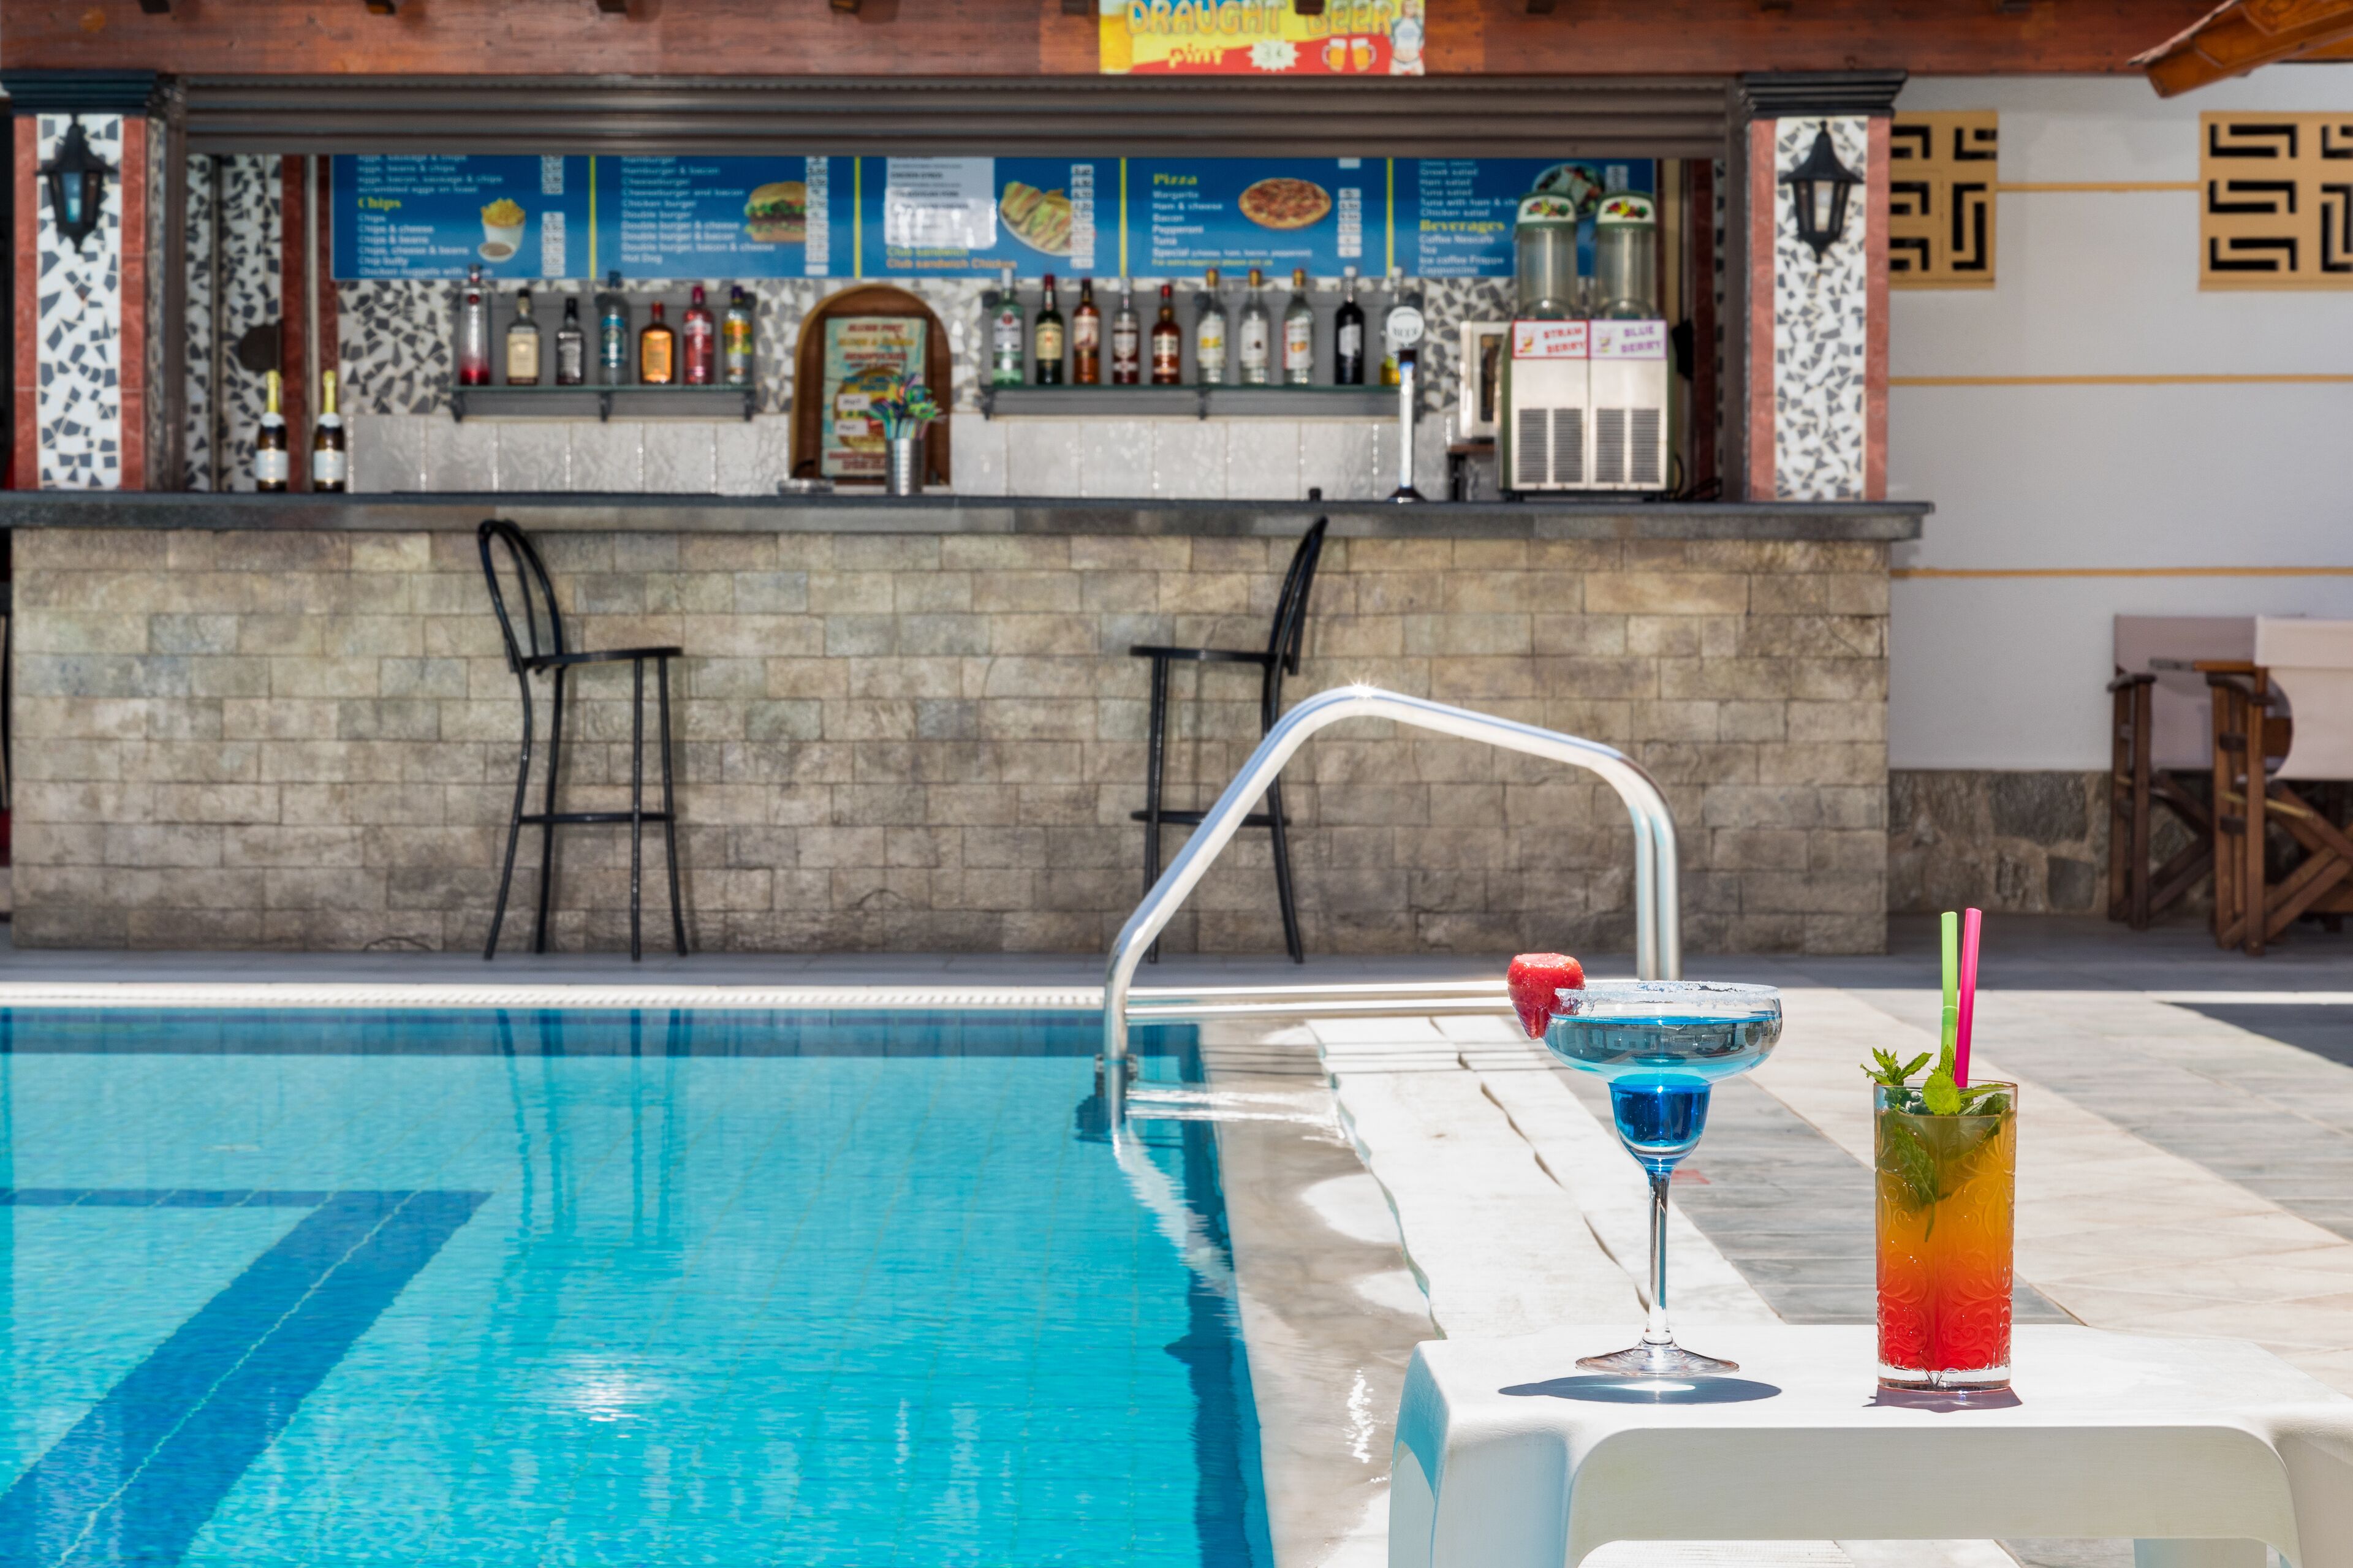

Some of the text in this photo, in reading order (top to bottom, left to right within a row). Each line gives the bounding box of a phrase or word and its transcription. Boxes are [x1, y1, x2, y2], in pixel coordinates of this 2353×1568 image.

[1126, 0, 1393, 36] DRAUGHT BEER
[1169, 42, 1224, 68] pint
[622, 167, 675, 176] Hamburger
[622, 176, 690, 187] Cheeseburger
[1153, 173, 1197, 186] Pizza
[622, 187, 690, 198] Cheeseburger
[358, 197, 401, 211] Chips
[622, 199, 696, 210] Chicken burger
[1420, 197, 1443, 206] Tuna
[1447, 198, 1467, 206] with
[1494, 197, 1500, 206] &
[623, 210, 691, 221] Double burger
[1153, 213, 1184, 222] Bacon
[1420, 208, 1460, 217] Chicken
[358, 213, 386, 224] Chips
[358, 224, 433, 234] Chips & cheese
[622, 221, 739, 232] Double burger & cheese
[1152, 224, 1203, 235] Pepperoni
[1420, 219, 1505, 234] Beverages
[358, 235, 428, 244] Chips & beans
[622, 231, 735, 242] Double burger & bacon
[1153, 235, 1177, 246] Tuna
[1419, 234, 1451, 244] Coffee
[392, 246, 426, 255] cheese
[430, 246, 436, 255] &
[439, 246, 469, 255] beans
[622, 242, 656, 252] Double
[697, 243, 727, 252] bacon
[730, 243, 737, 252] &
[740, 243, 775, 252] cheese
[887, 246, 969, 257] Club sandwich
[1153, 246, 1189, 258] Special
[1419, 245, 1437, 255] Tea
[358, 256, 380, 267] Chip
[622, 253, 662, 265] Hot Dog
[887, 258, 1017, 269] Club sandwich Chicken
[1419, 256, 1434, 265] Ice
[1436, 256, 1467, 265] coffee
[359, 267, 397, 276] Chicken
[401, 268, 439, 278] nuggets
[443, 267, 462, 276] with
[1419, 266, 1478, 276] Cappuccino
[1543, 327, 1582, 339] STRAW
[1624, 325, 1654, 338] BLUE
[1546, 341, 1585, 354] BERRY
[1621, 340, 1661, 354] BERRY
